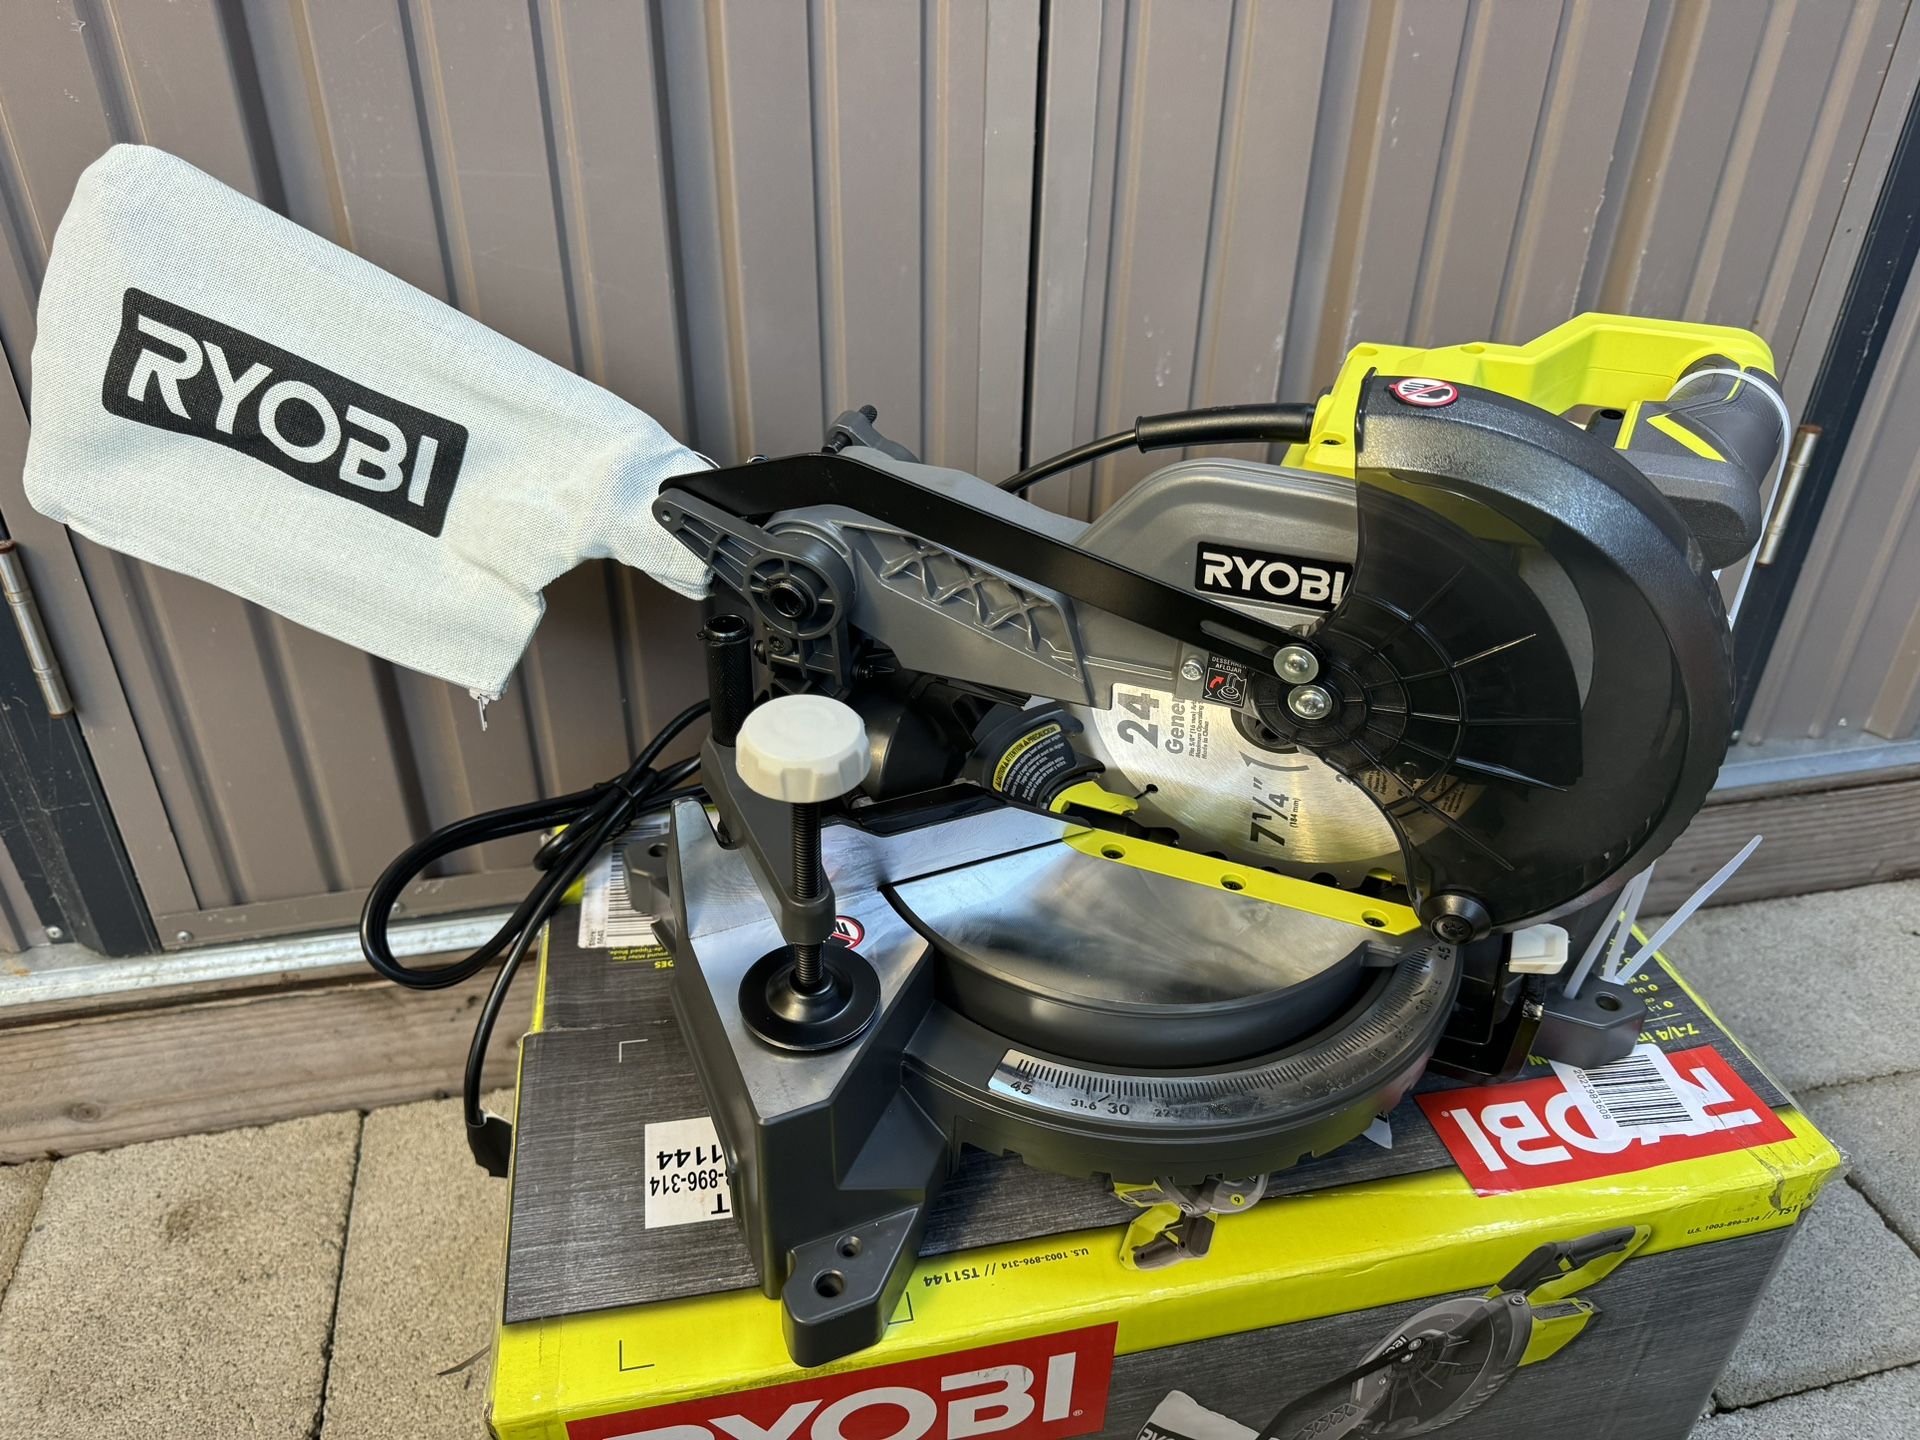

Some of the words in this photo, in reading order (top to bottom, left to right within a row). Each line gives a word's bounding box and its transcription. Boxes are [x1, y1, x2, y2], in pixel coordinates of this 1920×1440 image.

[127, 314, 438, 507] RYOBI
[1202, 552, 1345, 604] RYOBI
[1215, 663, 1243, 674] AFLOJAR
[1117, 693, 1160, 749] 24
[1416, 998, 1433, 1014] 30
[1656, 1022, 1700, 1043] 7-1/4
[1010, 1079, 1033, 1096] 45
[1070, 1098, 1098, 1111] 31.6
[1107, 1102, 1130, 1116] 30
[656, 1144, 722, 1170] 1144
[1001, 1251, 1068, 1270] 1003-896-314
[1070, 1247, 1089, 1256] U.S.
[923, 1267, 980, 1288] TS1144
